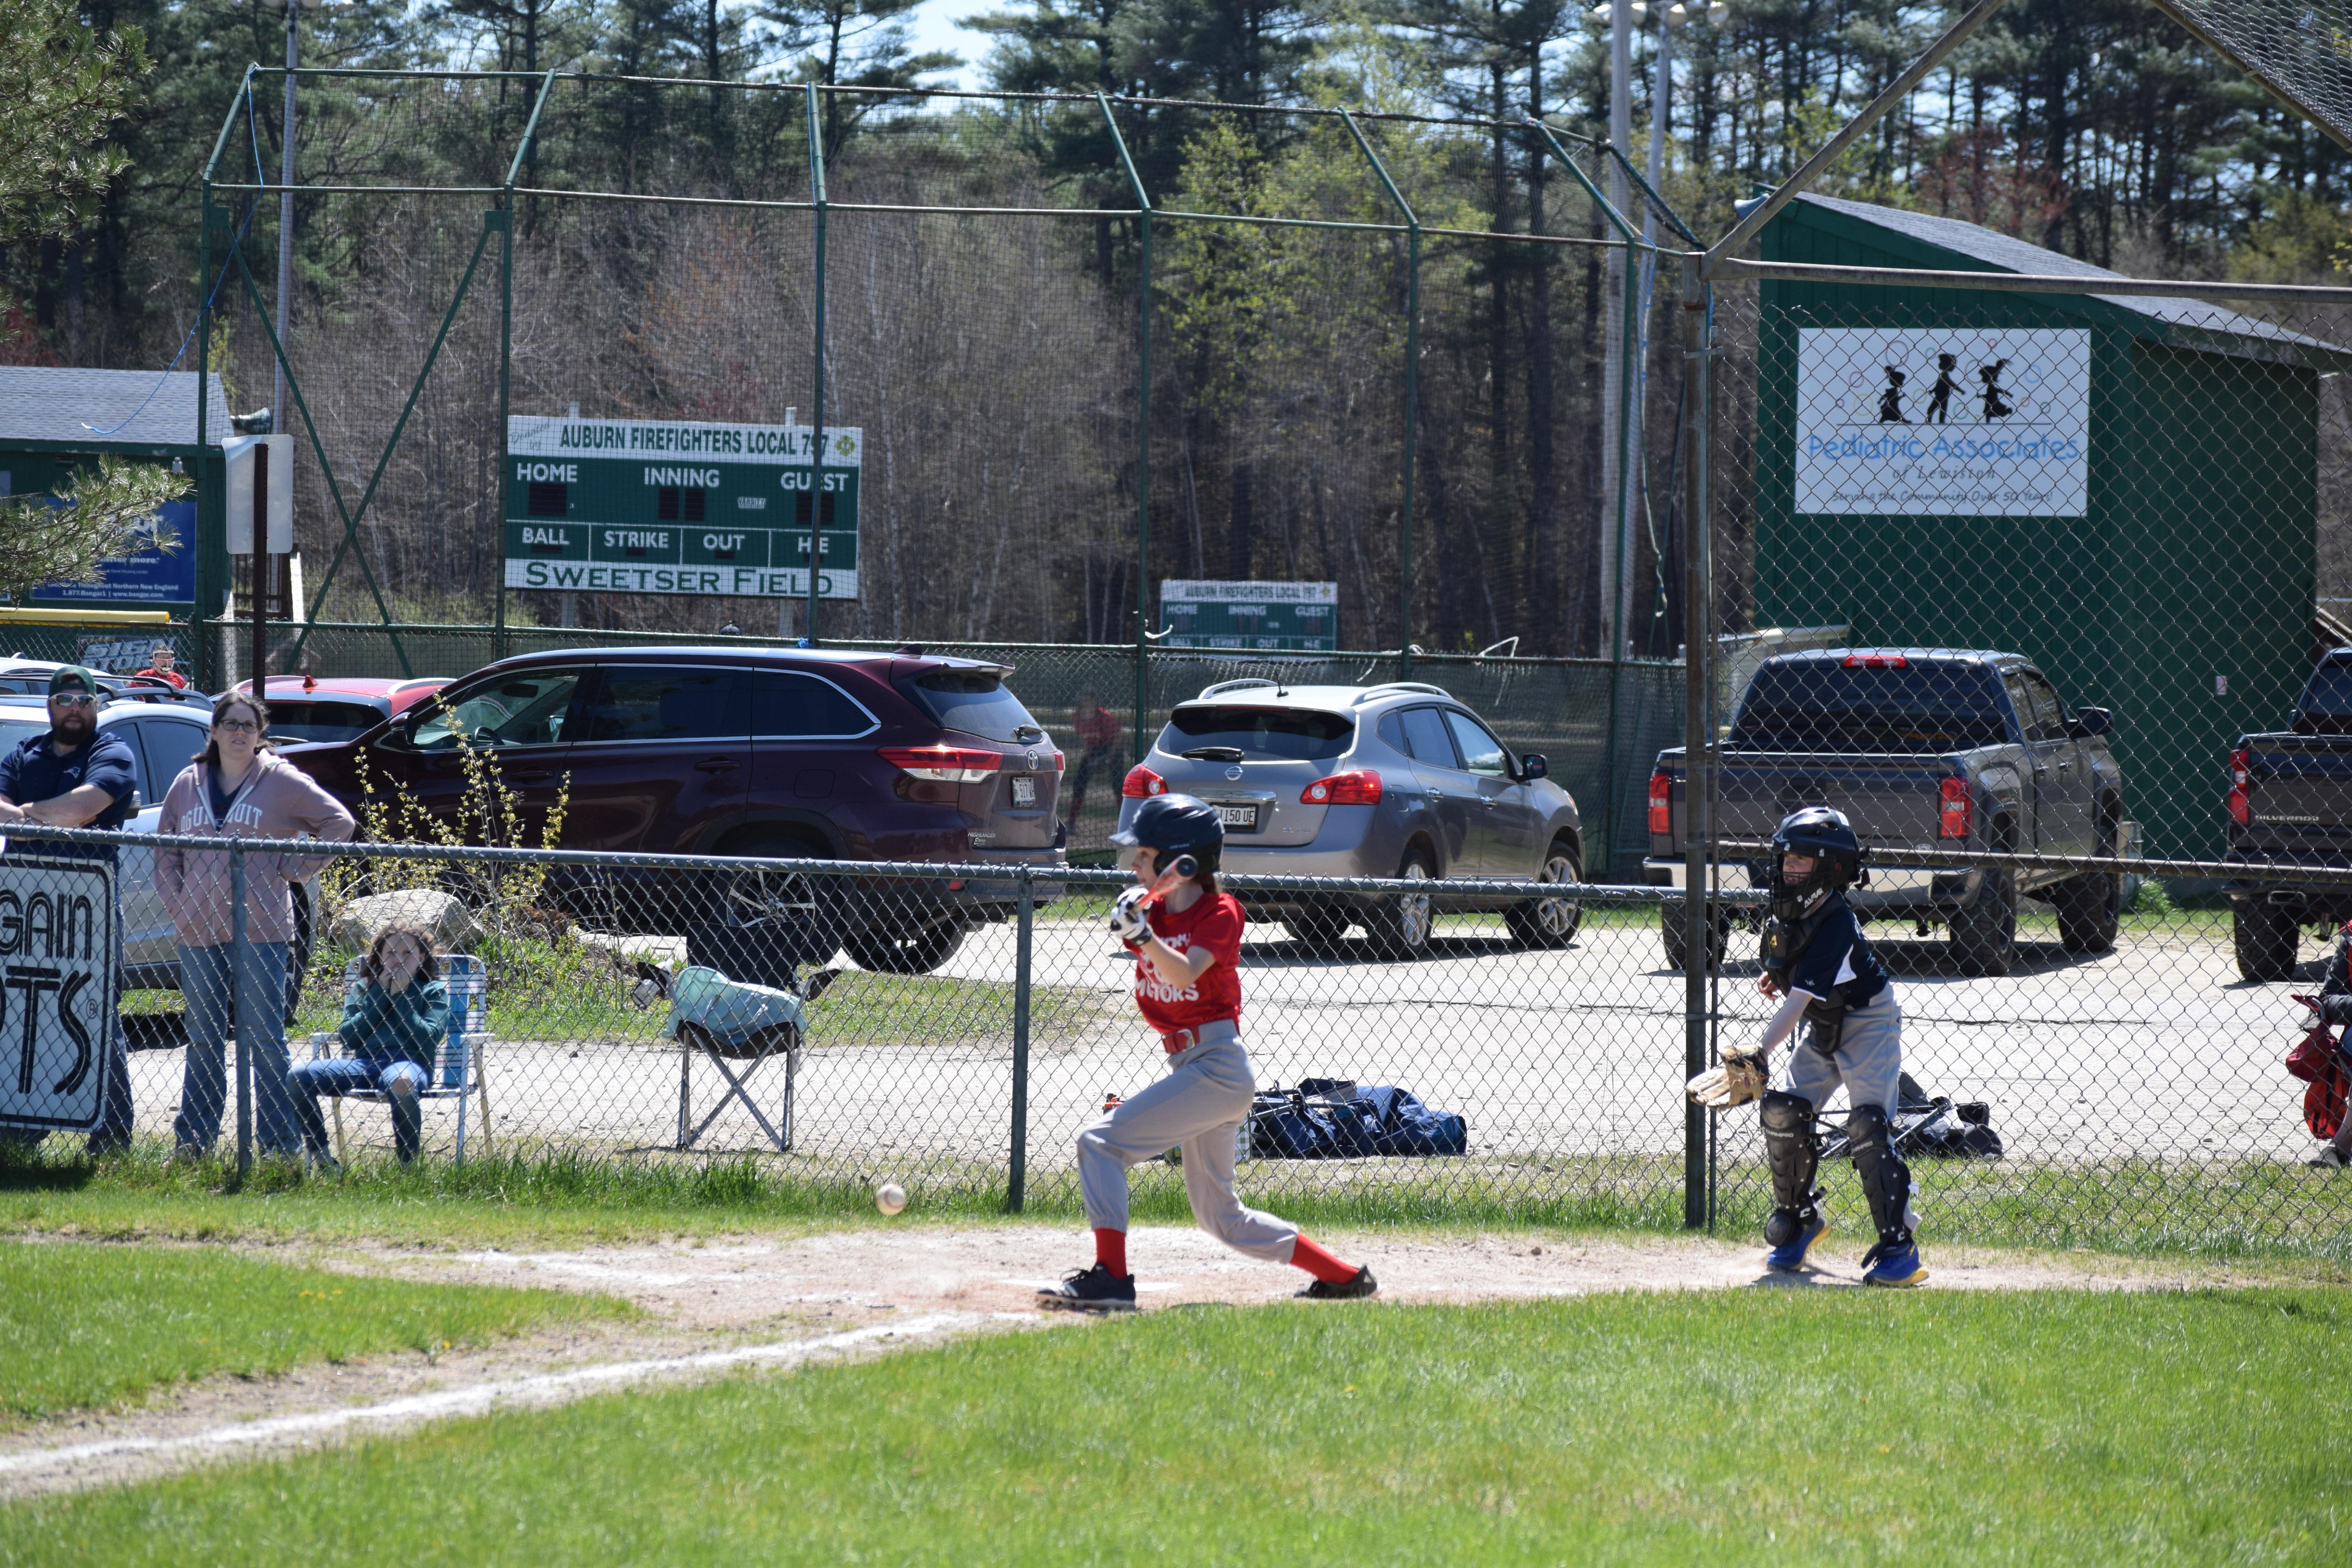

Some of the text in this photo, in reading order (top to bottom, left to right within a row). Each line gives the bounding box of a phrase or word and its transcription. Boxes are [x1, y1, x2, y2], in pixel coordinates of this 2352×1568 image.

[530, 439, 541, 452] by
[560, 425, 829, 456] AUBURN FIREFIGHTERS LOCAL 77
[1809, 433, 2078, 460] Pediatric Associates
[517, 463, 578, 482] HOME
[644, 467, 720, 488] INNING
[1892, 464, 1995, 483] of Lewiston
[780, 472, 848, 492] GUST
[1832, 490, 1875, 503] Serving
[1878, 490, 1897, 501] the
[1901, 490, 1966, 504] Community
[1972, 491, 1999, 501] Over
[2004, 492, 2018, 501] 50
[522, 527, 570, 545] BALL
[604, 530, 669, 548] STRIKE
[703, 534, 745, 550] OUT
[1167, 604, 1198, 615] HOME
[1295, 606, 1330, 617] GUEST
[1256, 639, 1279, 649] OUT
[1243, 810, 1254, 822] UE
